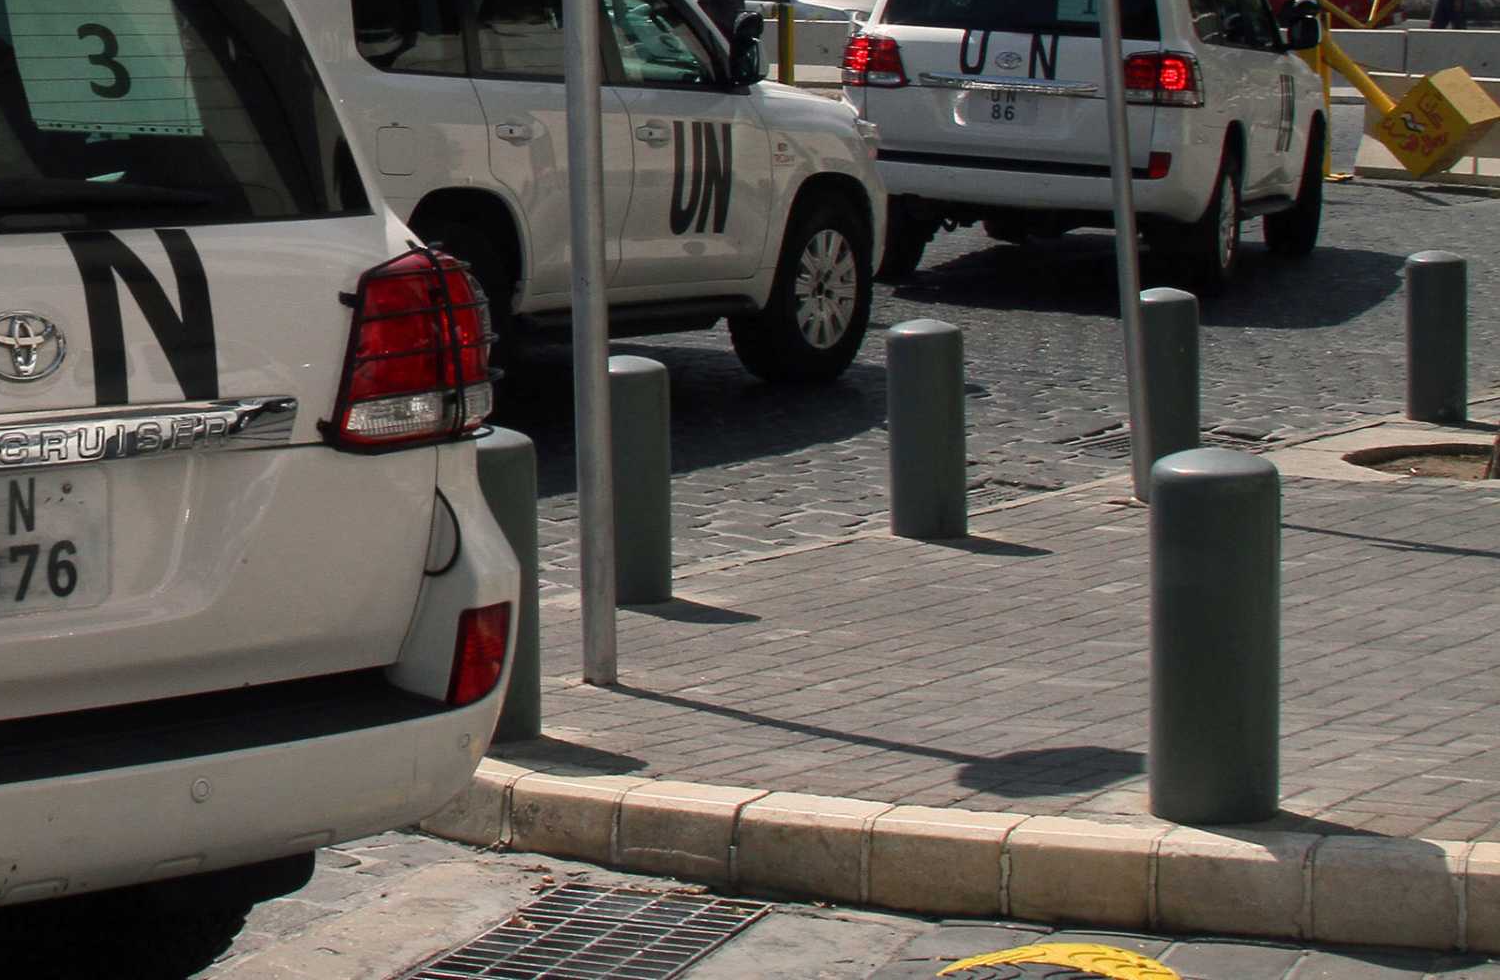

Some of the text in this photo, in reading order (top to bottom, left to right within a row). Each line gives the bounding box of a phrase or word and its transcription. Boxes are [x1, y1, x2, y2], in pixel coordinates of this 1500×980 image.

[77, 23, 132, 99] 3
[991, 104, 1015, 120] 86
[670, 120, 732, 235] UN
